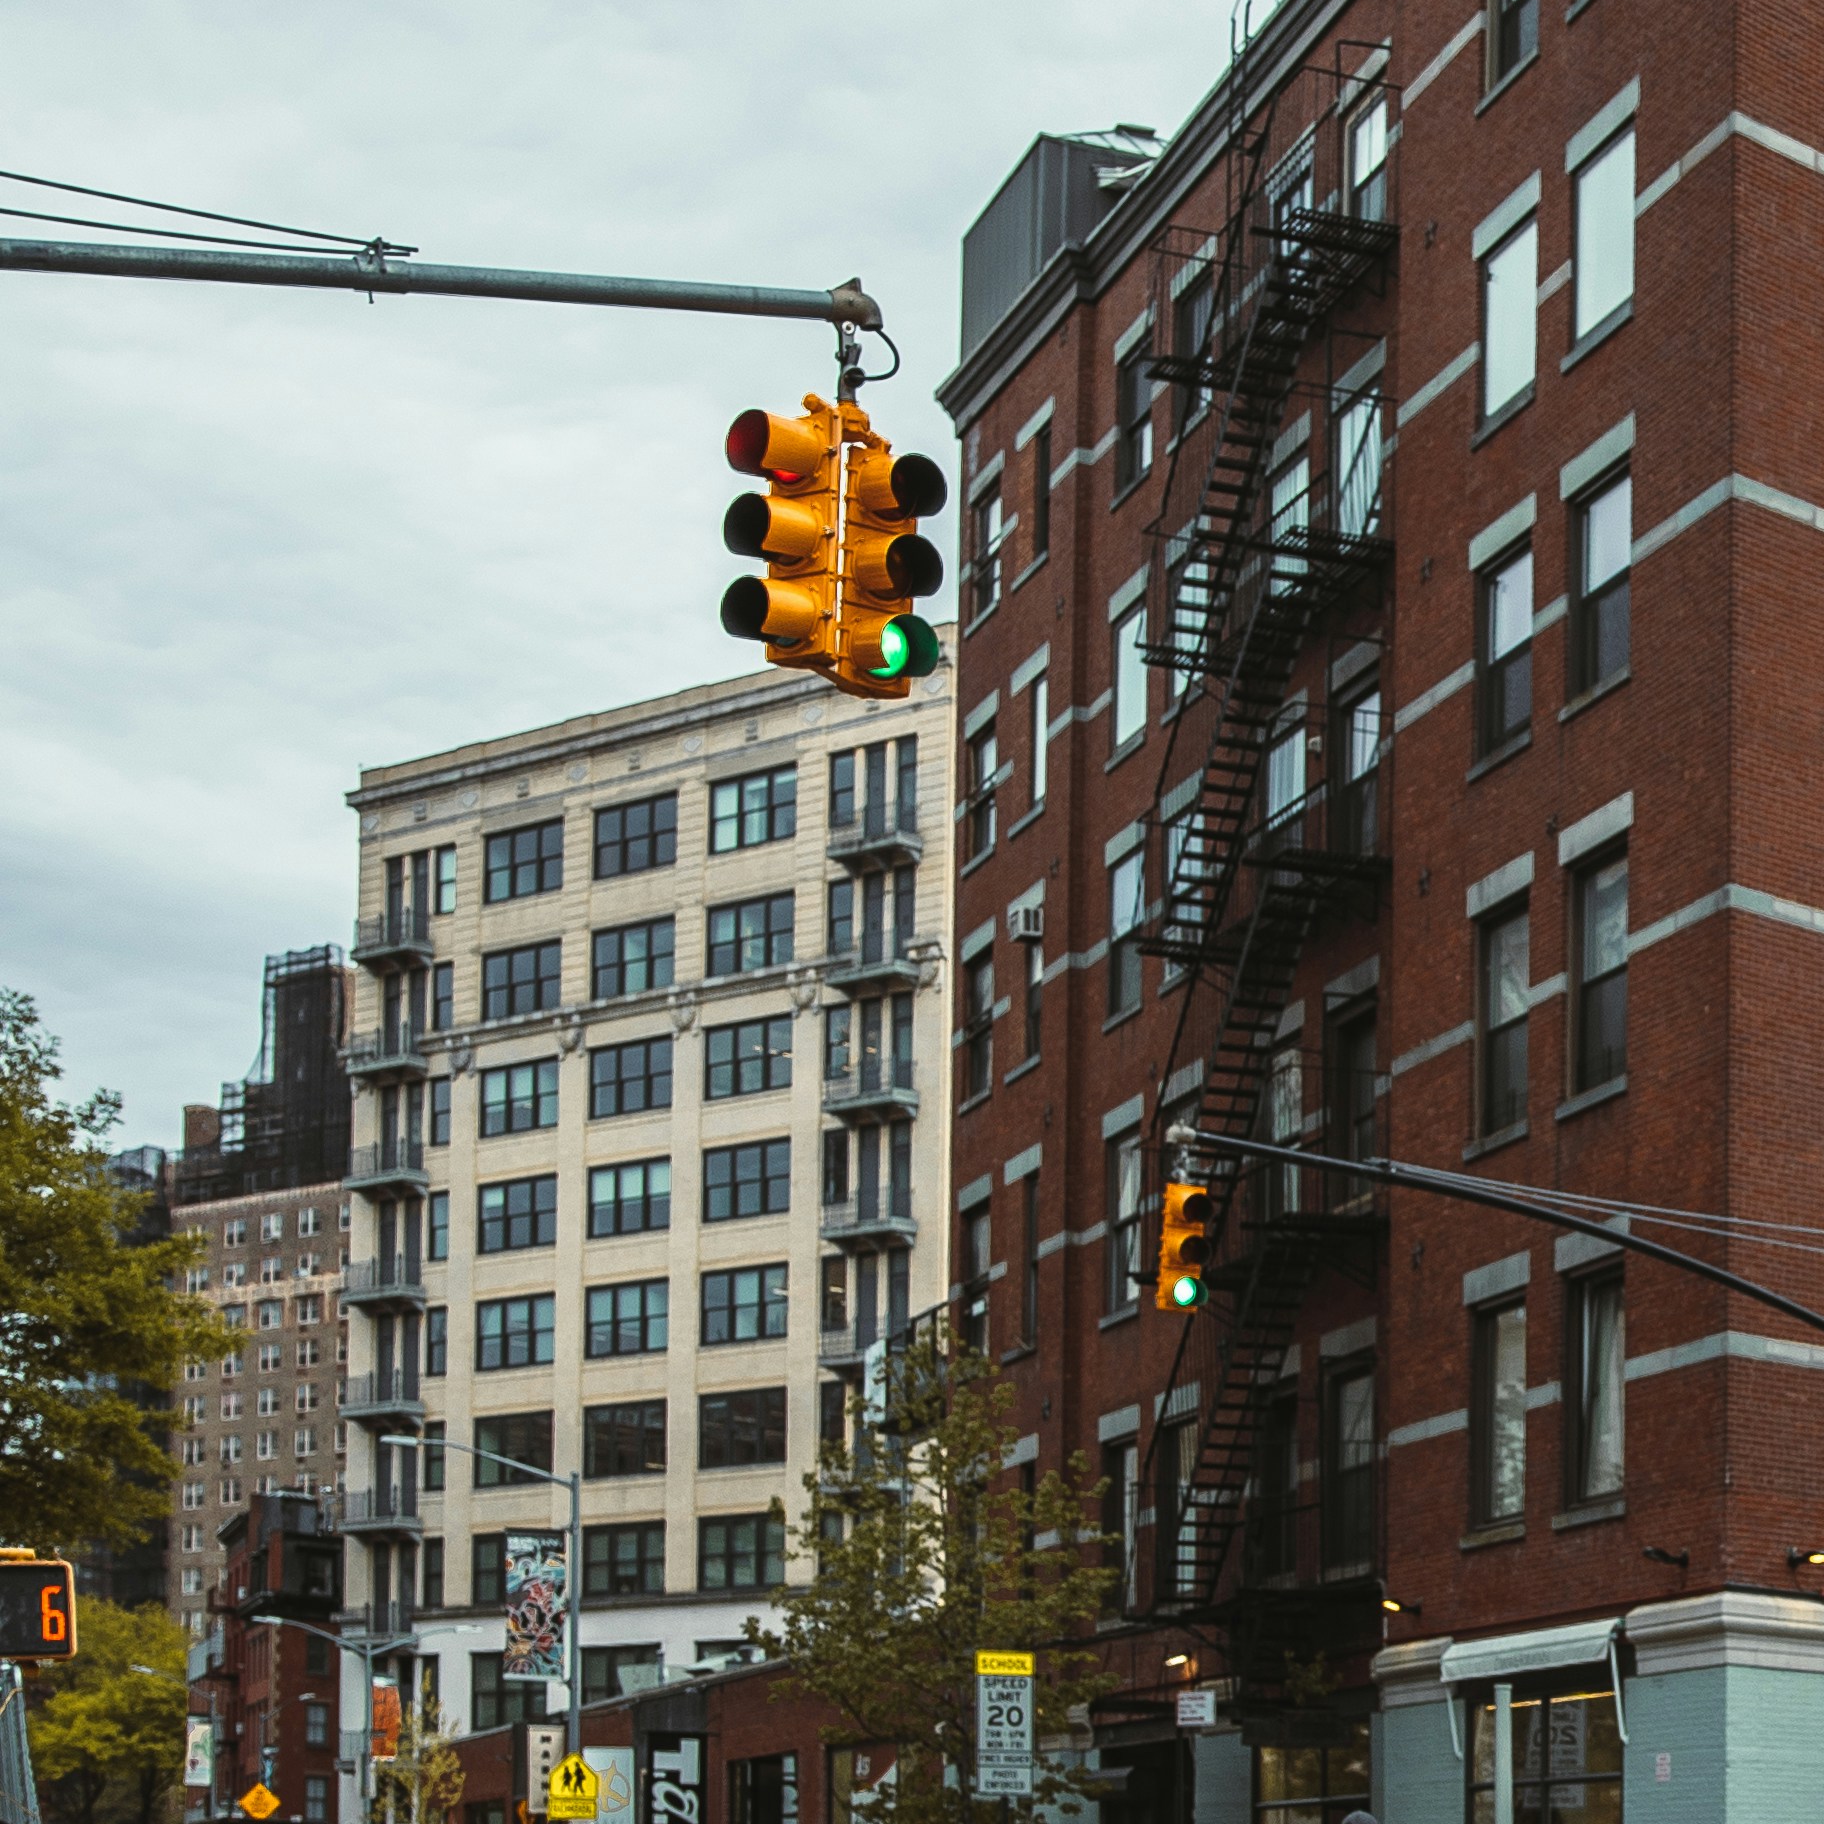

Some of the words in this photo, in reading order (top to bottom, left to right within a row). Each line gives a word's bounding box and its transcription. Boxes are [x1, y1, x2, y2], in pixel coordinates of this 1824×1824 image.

[41, 1585, 65, 1642] 6
[981, 1657, 1028, 1671] SCHOOL
[983, 1678, 1028, 1689] SPEED
[987, 1691, 1022, 1703] LIMIT
[987, 1705, 1024, 1727] 20
